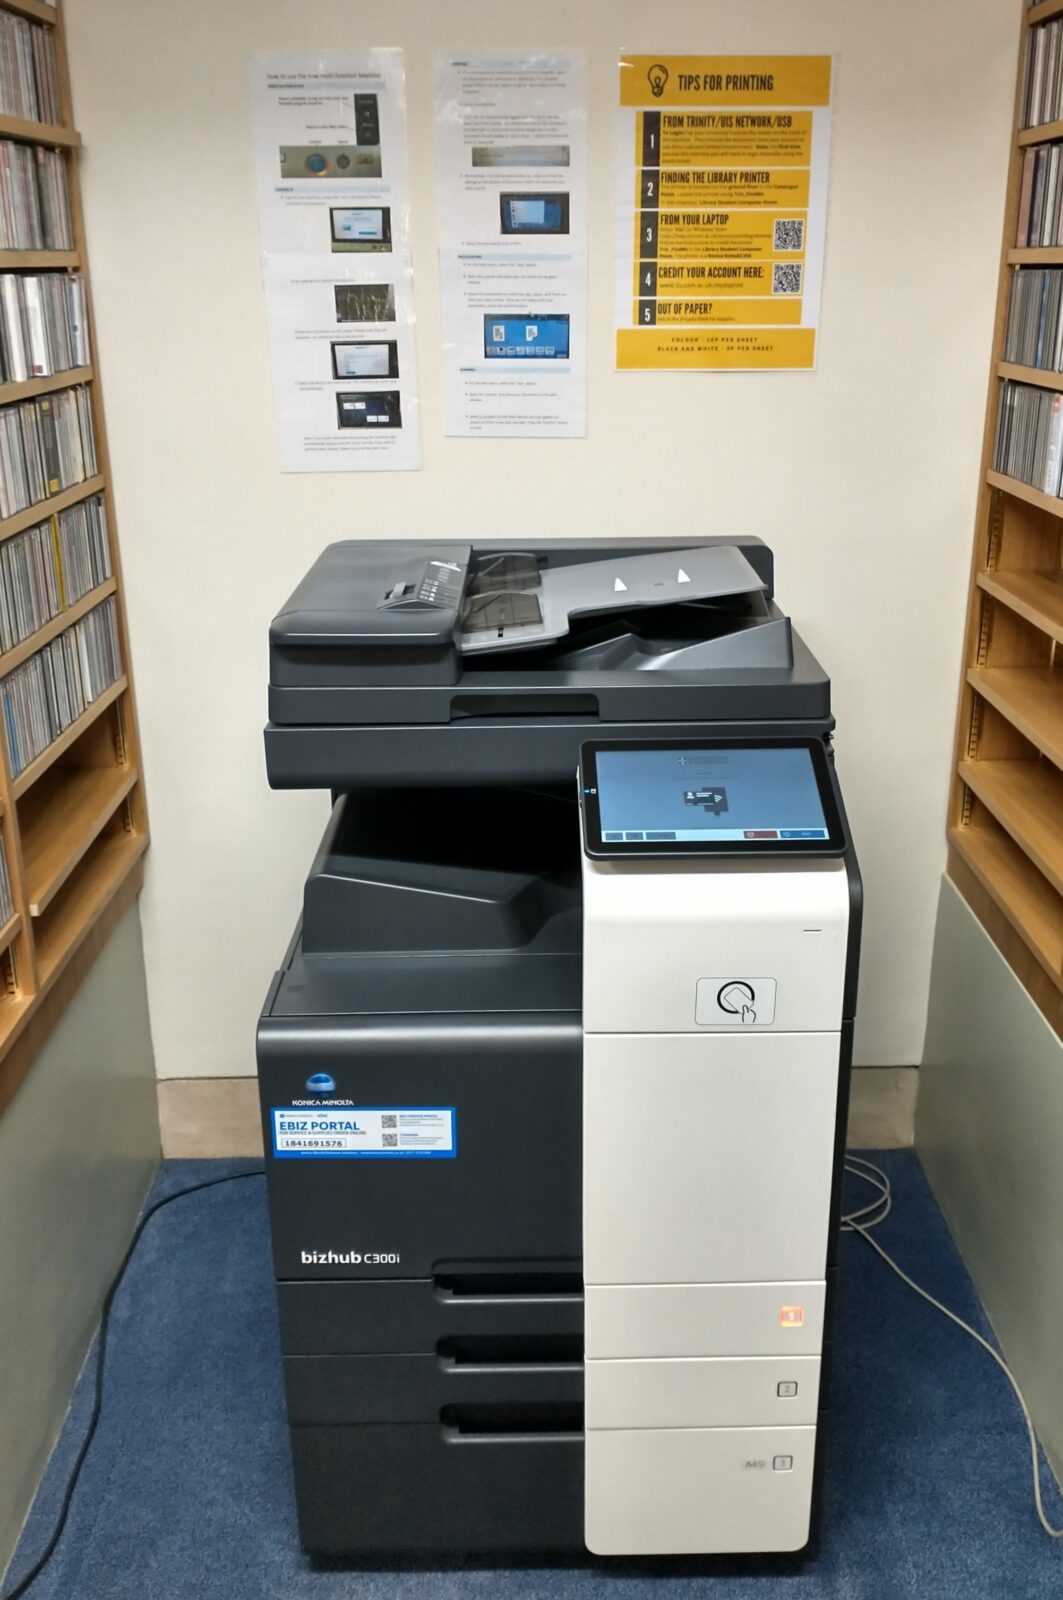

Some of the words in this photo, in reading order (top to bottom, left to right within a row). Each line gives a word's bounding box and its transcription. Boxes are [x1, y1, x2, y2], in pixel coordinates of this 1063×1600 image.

[677, 74, 701, 91] TIPS
[703, 74, 722, 91] FOR
[725, 74, 774, 91] PRINTING
[663, 115, 684, 128] FROM
[686, 115, 734, 128] TRINITY/UIS
[735, 115, 792, 128] NETWORK/USB
[650, 134, 655, 149] 1
[661, 172, 690, 184] FINDING
[692, 172, 705, 184] THE
[707, 172, 737, 184] LIBRARY
[740, 172, 770, 184] PRINTER
[647, 182, 654, 197] 2
[660, 214, 680, 226] FROM
[682, 214, 701, 226] YOUR
[702, 214, 729, 226] LAPTOP
[646, 227, 653, 242] 3
[659, 266, 685, 279] CREDIT
[686, 266, 706, 279] YOUR
[707, 266, 742, 279] ACCOUNT
[743, 266, 765, 279] HERE:
[645, 273, 651, 286] 4
[644, 308, 650, 322] 5
[658, 303, 672, 315] OUT
[674, 303, 683, 315] OF
[685, 303, 713, 315] PAPER?
[279, 1121, 309, 1131] EBIZ
[311, 1121, 360, 1131] PORTAL
[285, 1140, 343, 1148] 1841691576
[301, 1250, 362, 1264] bizhub
[363, 1253, 401, 1264] C300i
